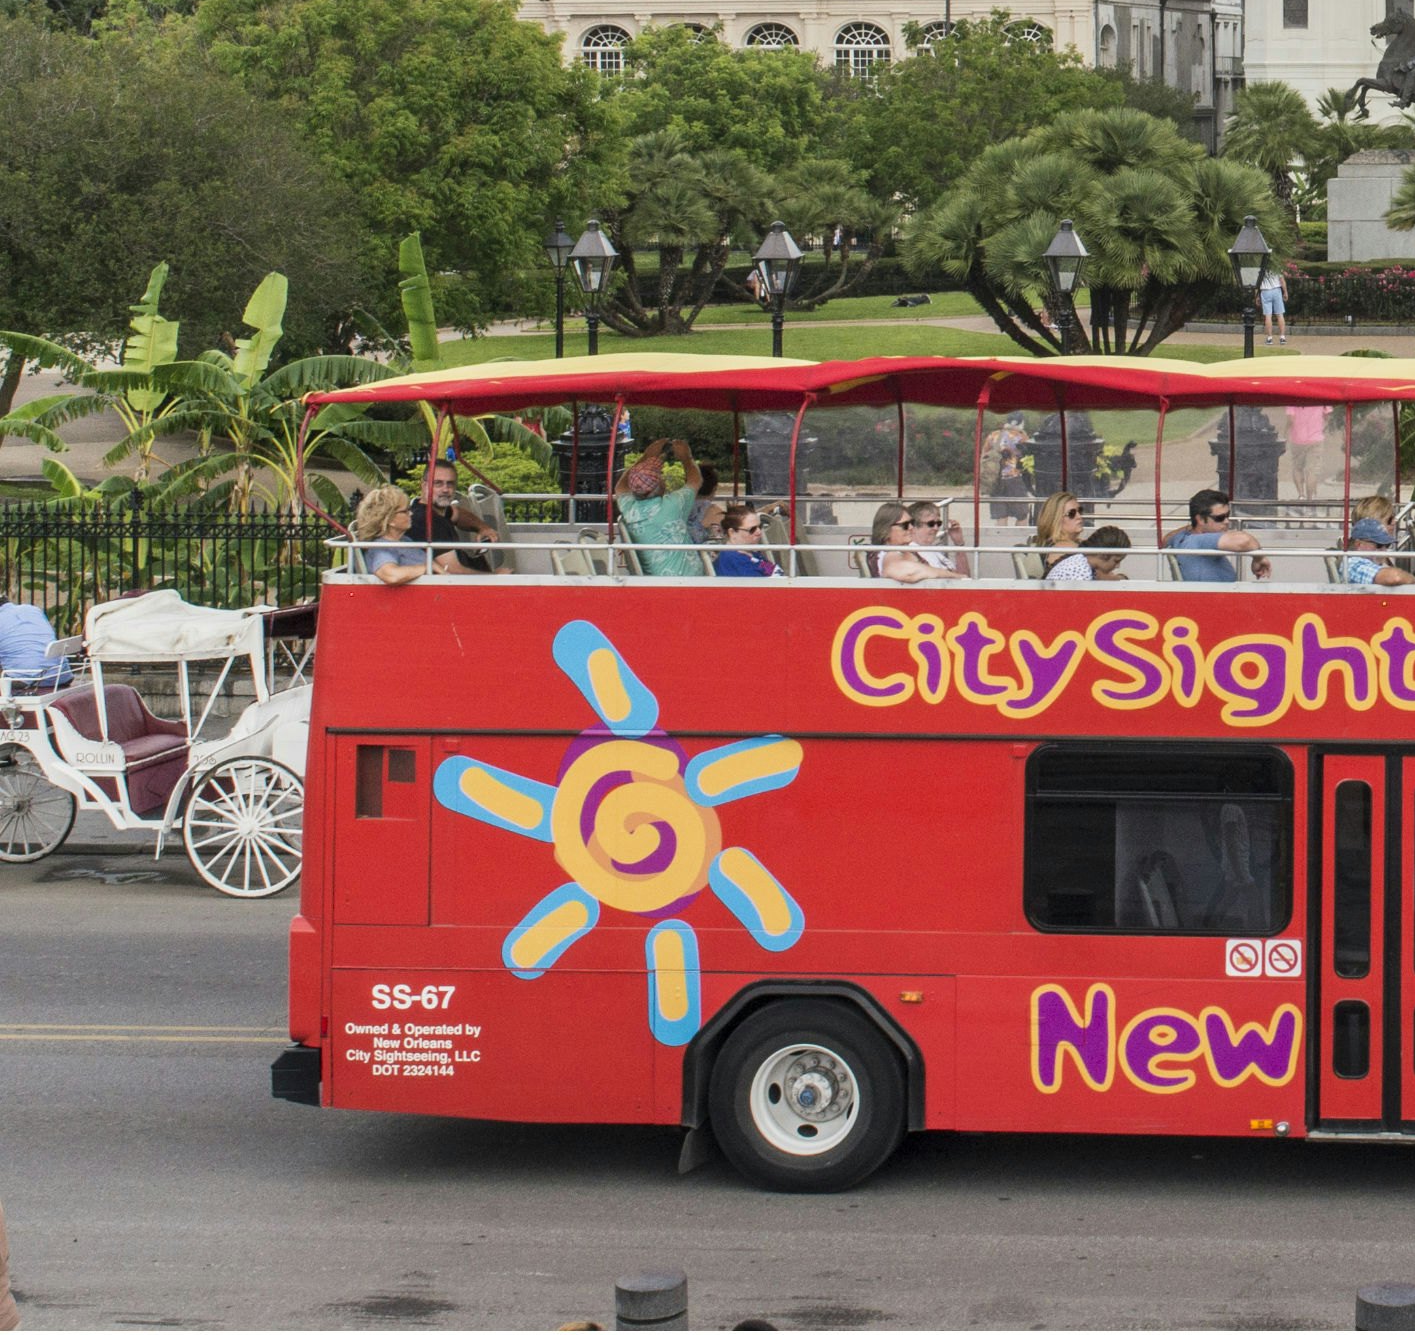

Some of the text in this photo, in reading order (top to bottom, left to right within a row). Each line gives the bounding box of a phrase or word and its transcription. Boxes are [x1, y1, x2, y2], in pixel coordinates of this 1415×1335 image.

[371, 983, 456, 1010] SS-67
[345, 1023, 482, 1037] Owned & Operated by
[373, 1037, 453, 1049] New Orleans
[1031, 982, 1303, 1094] New
[346, 1049, 481, 1063] City Sightseeing, LLC
[372, 1064, 455, 1076] DOT 2324144
